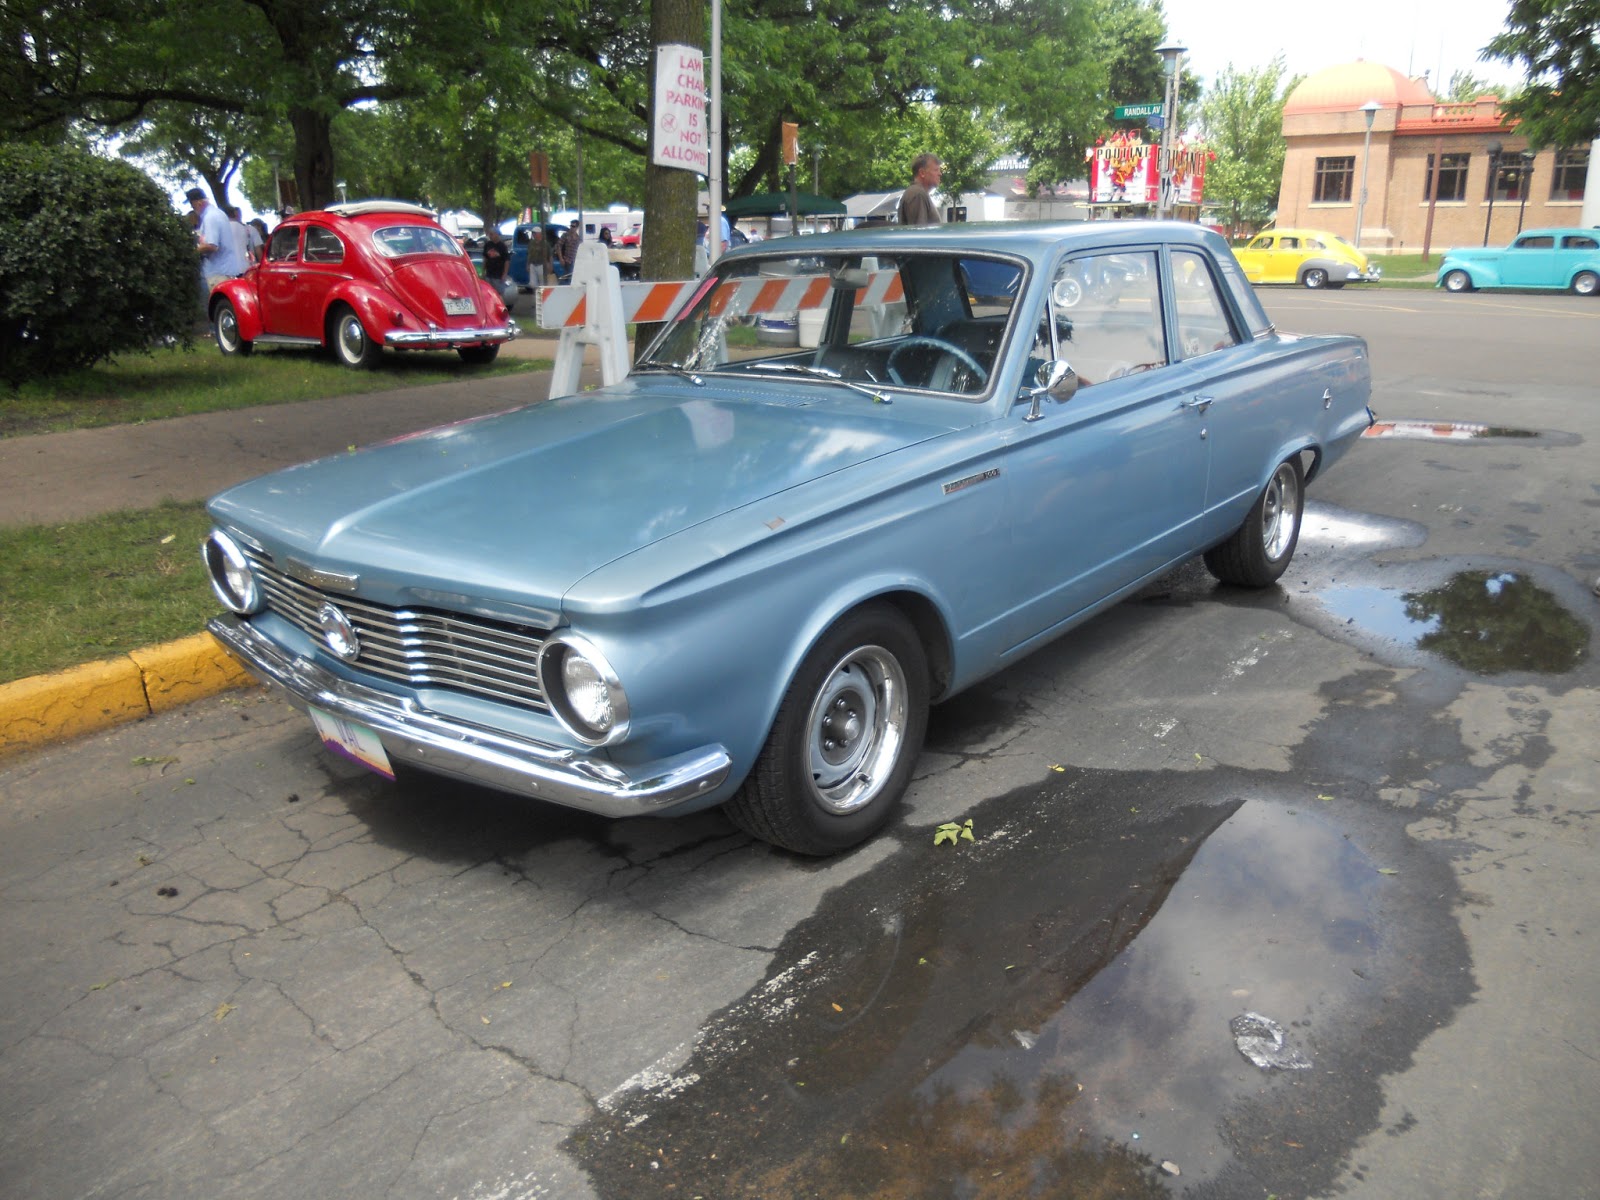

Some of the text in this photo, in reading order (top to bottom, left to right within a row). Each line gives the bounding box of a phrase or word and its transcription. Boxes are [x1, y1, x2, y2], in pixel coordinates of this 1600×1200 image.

[688, 112, 698, 127] IS
[1123, 108, 1151, 117] RANDALL
[680, 130, 702, 145] NOT
